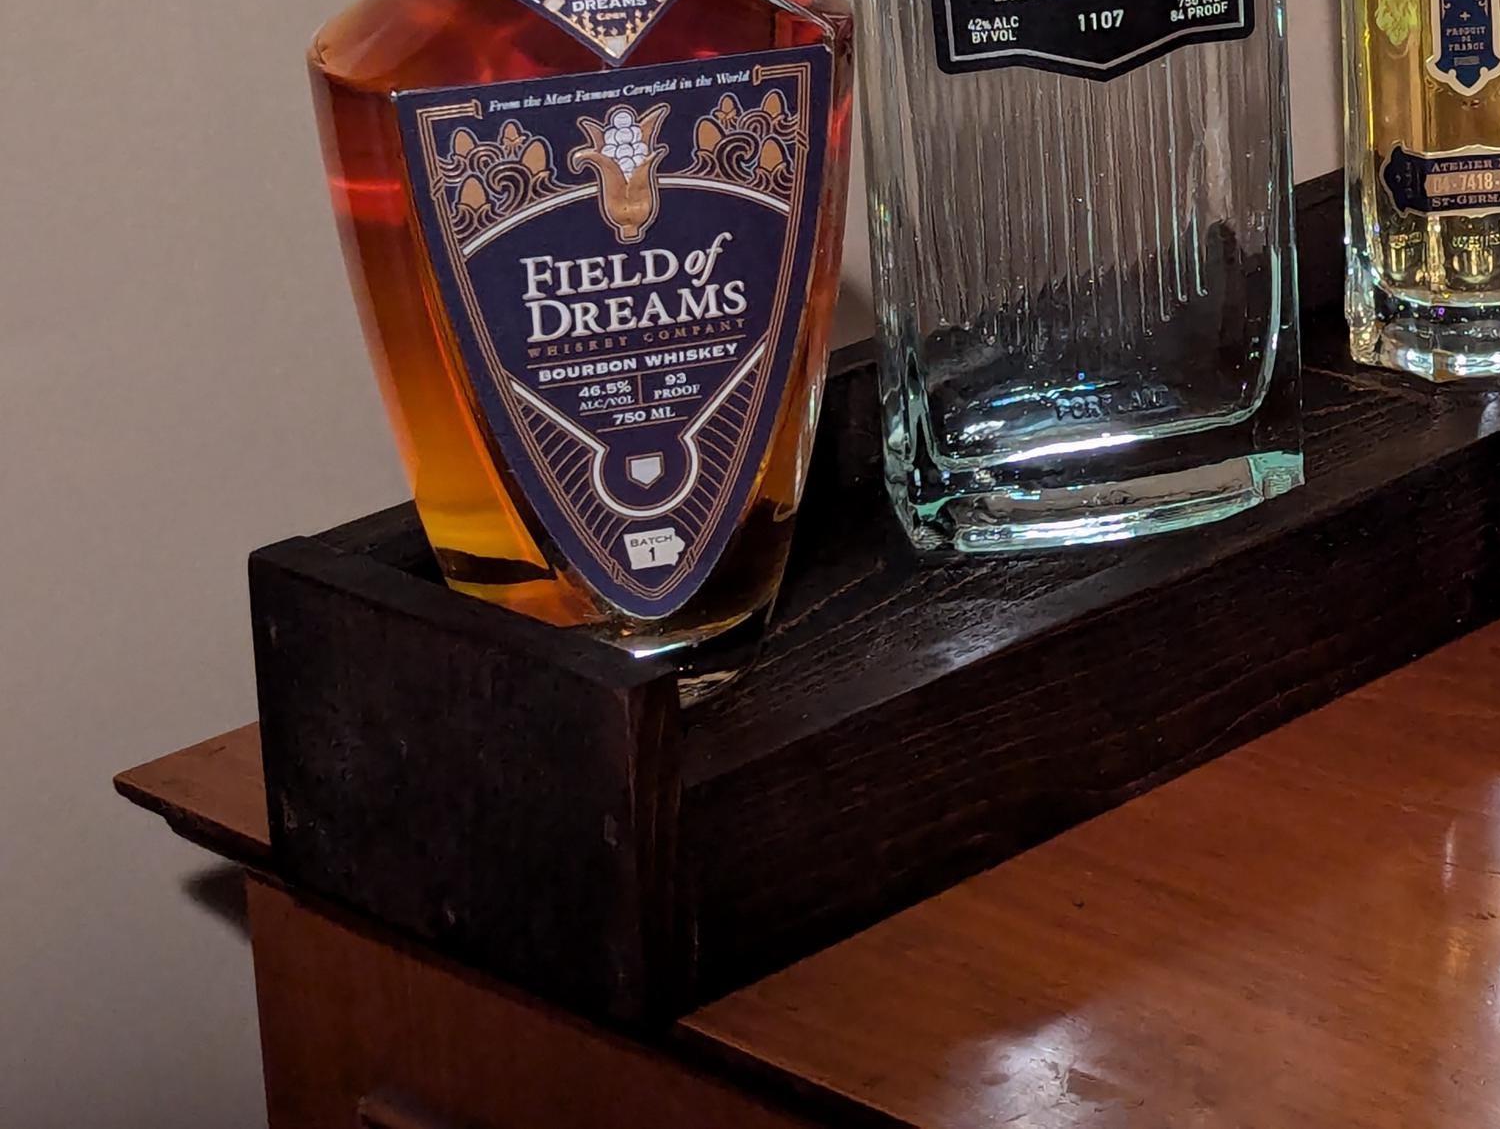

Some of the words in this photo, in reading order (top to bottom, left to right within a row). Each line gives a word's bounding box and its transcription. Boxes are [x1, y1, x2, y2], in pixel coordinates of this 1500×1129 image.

[1078, 9, 1124, 32] 1107
[1170, 9, 1186, 22] 84
[1188, 1, 1229, 19] PROOF
[967, 18, 991, 31] 42%
[994, 16, 1020, 29] ALC
[971, 31, 989, 44] BY
[990, 29, 1017, 42] VOL
[489, 99, 520, 112] From
[523, 96, 542, 108] the
[544, 93, 572, 106] Most
[575, 89, 621, 103] Famous
[622, 79, 677, 96] Cornfield
[680, 78, 693, 90] in
[695, 75, 713, 87] the
[716, 70, 750, 85] World
[1431, 159, 1492, 173] ATELIER
[520, 247, 680, 301] FIELD
[683, 231, 733, 291] of
[523, 279, 748, 343] DREAMS
[642, 318, 747, 343] COMPANY
[538, 358, 637, 382] BOURBON
[645, 343, 739, 368] WHISKEY
[664, 372, 687, 385] 93
[578, 380, 632, 398] 46.5%
[654, 384, 701, 399] PROOF
[579, 395, 635, 411] ALC/VOL
[612, 410, 647, 425] 750
[650, 406, 676, 419] ML
[630, 535, 674, 549] BATCH
[648, 548, 656, 562] 1
